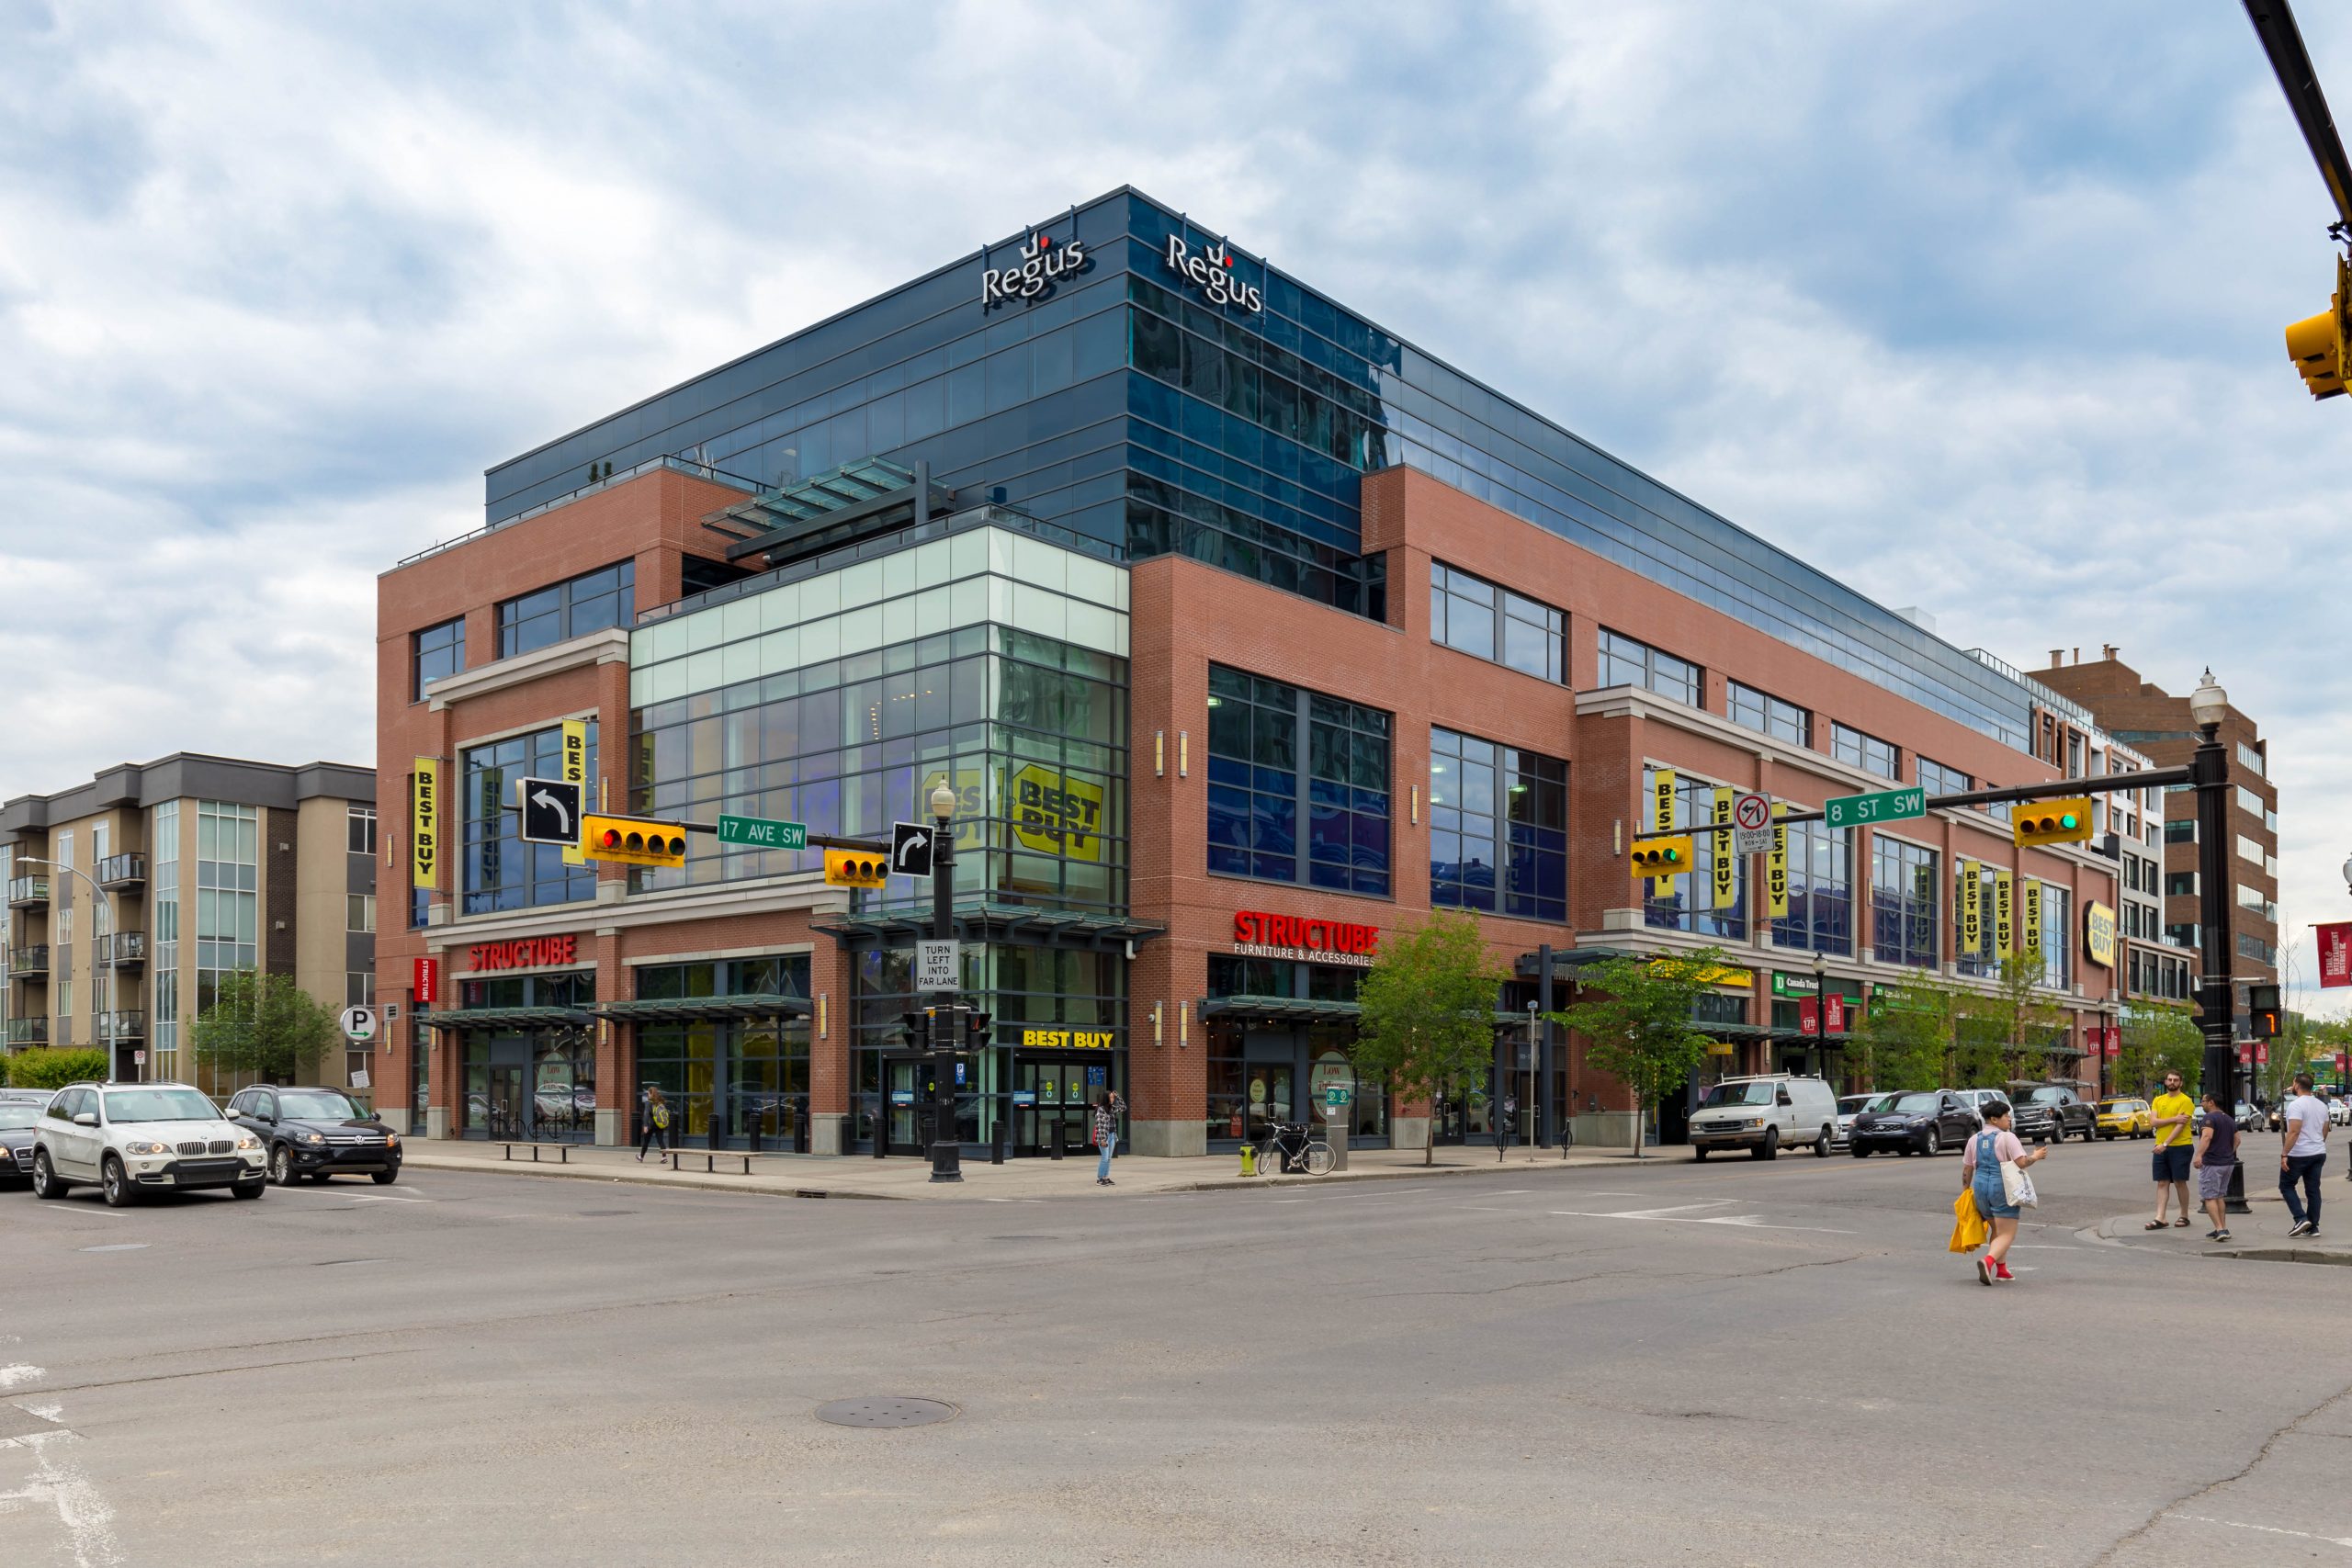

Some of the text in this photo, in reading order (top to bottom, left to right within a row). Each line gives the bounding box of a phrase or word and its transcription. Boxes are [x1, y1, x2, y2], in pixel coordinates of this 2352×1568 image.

[982, 240, 1084, 304] Regus
[1168, 233, 1261, 312] Regus
[566, 735, 582, 782] BES
[1019, 778, 1100, 826] BEST
[1831, 793, 1920, 822] 8 ST SW
[417, 771, 434, 874] BEST BUY
[723, 820, 803, 844] 17 AVE SW
[1021, 807, 1093, 849] BUY
[1717, 800, 1731, 895] BEST BUY
[1770, 828, 1784, 906] EST BUY
[1966, 871, 1978, 943] BEST BUY
[1998, 881, 2010, 950] BEST BUY
[2027, 888, 2038, 955] BEST BUY
[1234, 910, 1379, 955] STRUCTUBE
[2092, 912, 2113, 939] BEST
[468, 934, 577, 972] STRUCTUBE
[925, 945, 951, 954] TURN
[927, 955, 950, 964] LEFT
[1234, 942, 1375, 966] FURNITURE & ACCESSORIES
[2093, 932, 2112, 955] BUY
[919, 976, 958, 986] FAR LANE
[928, 965, 949, 975] INTO
[1786, 977, 1806, 988] Canada
[352, 1010, 368, 1031] P
[1023, 1030, 1114, 1049] BEST BUY
[1323, 1065, 1340, 1075] Low
